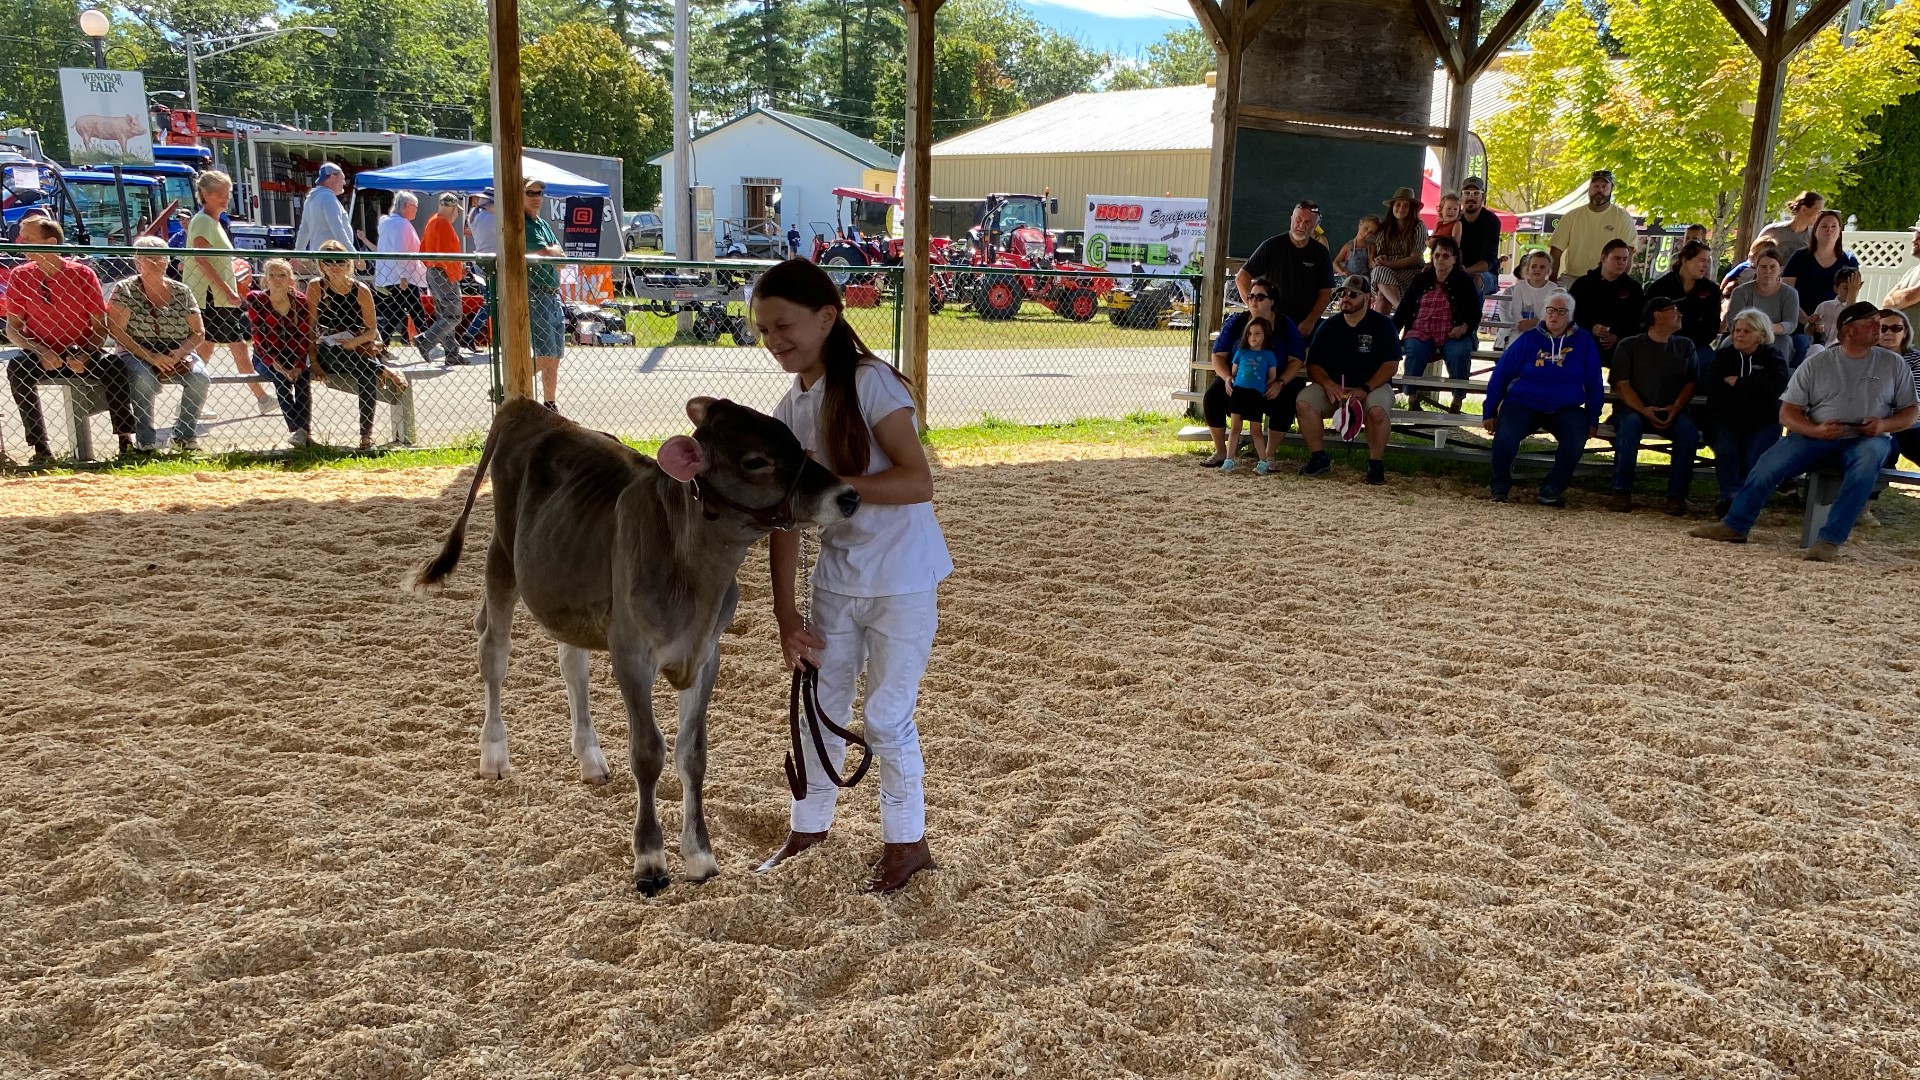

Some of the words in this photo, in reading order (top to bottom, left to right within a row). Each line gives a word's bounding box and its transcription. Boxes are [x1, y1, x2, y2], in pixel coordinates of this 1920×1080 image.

[81, 73, 123, 86] WINDSOR
[90, 82, 118, 92] FAIR
[226, 120, 261, 131] SERCO
[1095, 204, 1143, 221] HOOD
[1150, 209, 1207, 228] Equipmen
[1181, 228, 1207, 236] 207-225-2
[1108, 245, 1146, 254] GREENWORKS
